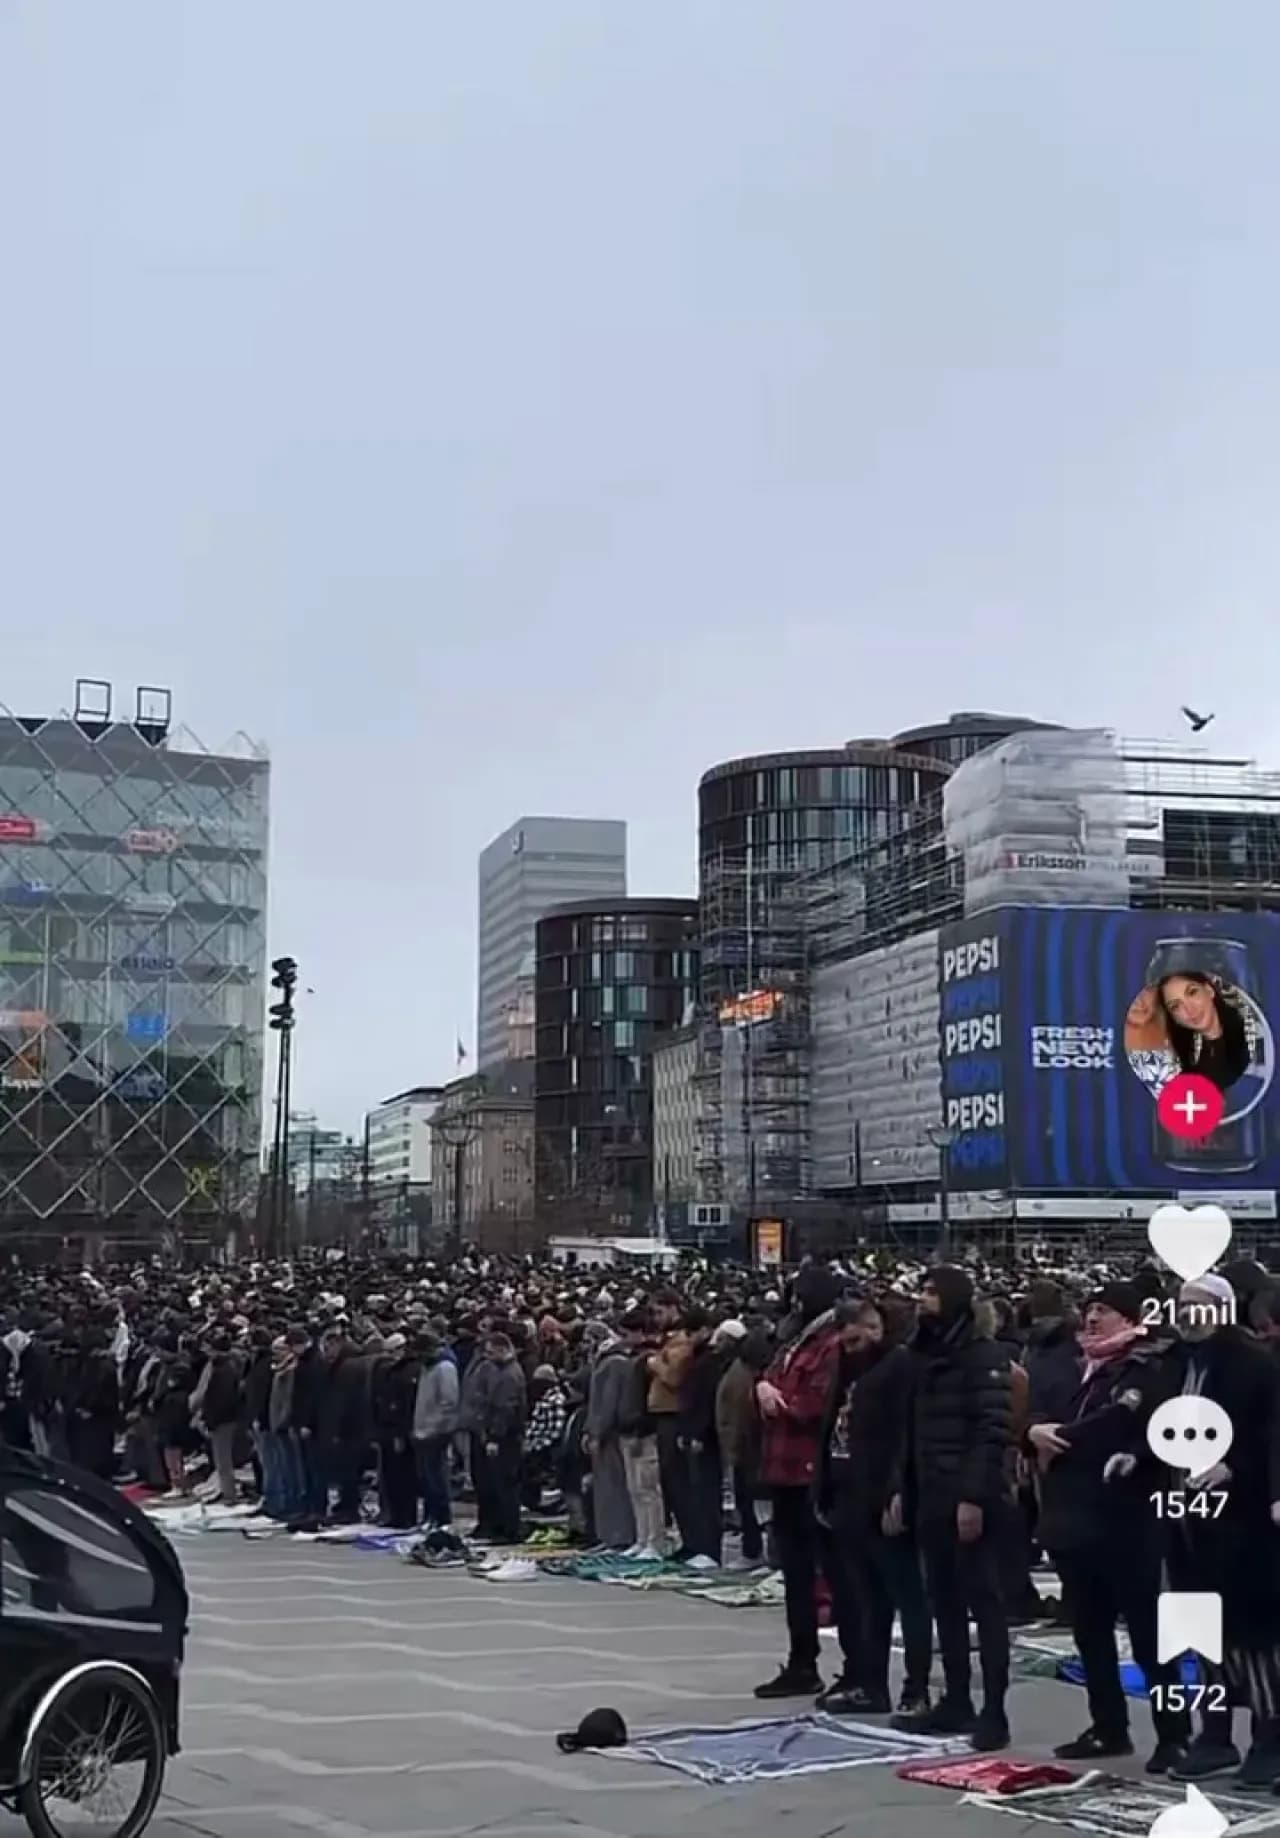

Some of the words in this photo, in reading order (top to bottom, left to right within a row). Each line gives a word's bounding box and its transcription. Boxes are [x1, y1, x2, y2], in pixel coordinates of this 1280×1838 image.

[1018, 853, 1086, 870] Eriksson
[943, 936, 999, 982] PEPSI
[946, 1013, 1001, 1056] PEPSI
[1032, 1027, 1114, 1040] FRESH
[1032, 1040, 1113, 1055] NEW
[1033, 1055, 1114, 1068] LOOK
[948, 1090, 1004, 1130] PEPSI
